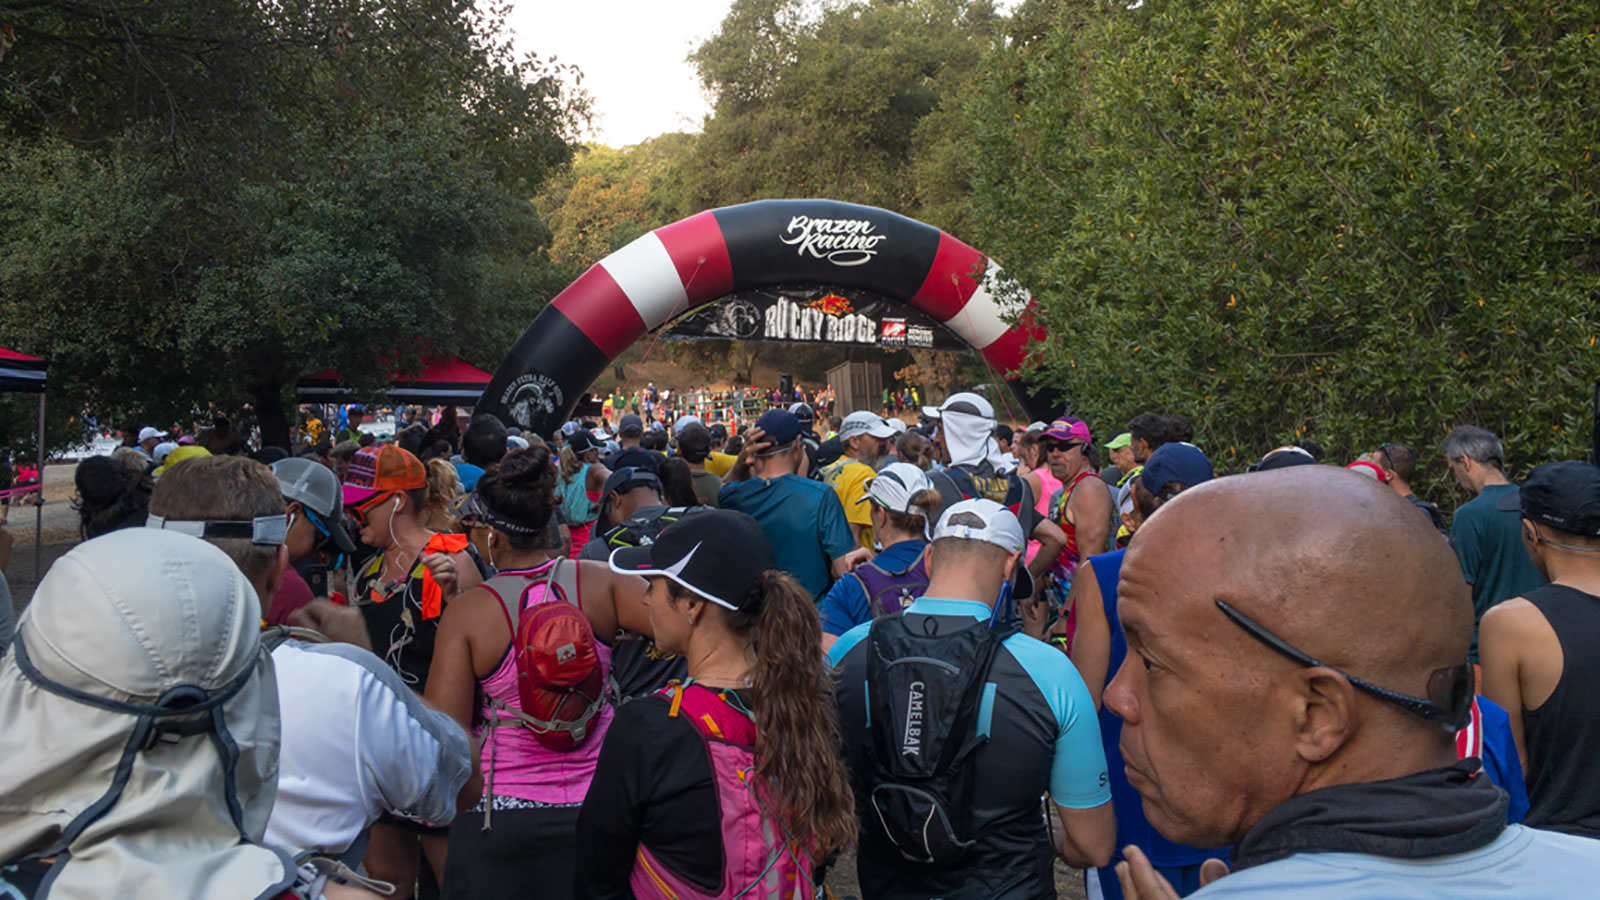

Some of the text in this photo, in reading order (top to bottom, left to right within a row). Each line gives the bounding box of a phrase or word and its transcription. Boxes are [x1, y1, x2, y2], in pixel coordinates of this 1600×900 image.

[779, 215, 876, 244] Brazen
[798, 232, 887, 266] Racing
[764, 296, 824, 340] ROCKY
[826, 313, 877, 343] RIDGE
[902, 681, 925, 756] CAMELBAK
